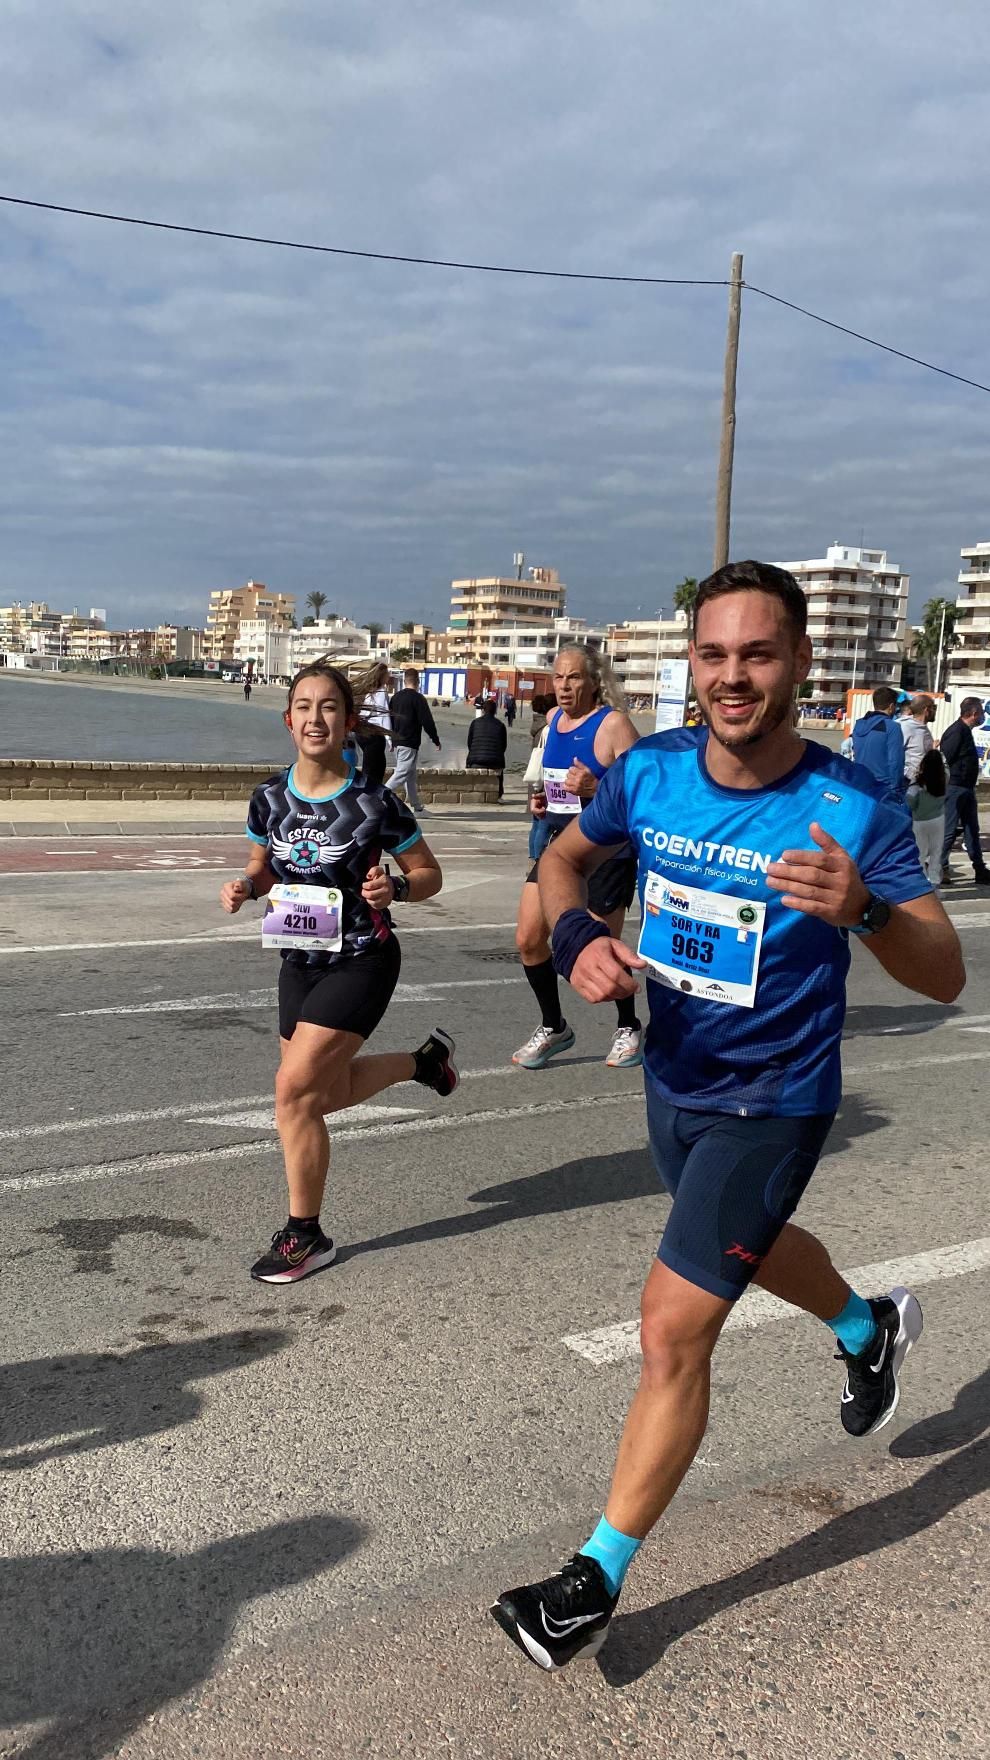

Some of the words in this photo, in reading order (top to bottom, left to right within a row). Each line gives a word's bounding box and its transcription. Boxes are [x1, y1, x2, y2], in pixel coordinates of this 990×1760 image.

[287, 827, 331, 846] ESTESO
[642, 827, 792, 874] COENTREN
[285, 863, 322, 874] RUNNERS
[655, 855, 702, 873] Preparación
[703, 866, 726, 879] física
[725, 871, 732, 881] y
[732, 873, 758, 886] Salud
[293, 903, 311, 914] SILVI
[283, 913, 317, 930] 4210
[671, 915, 693, 933] SOR
[695, 922, 703, 935] Y
[704, 925, 720, 940] RA
[671, 933, 714, 964] 963
